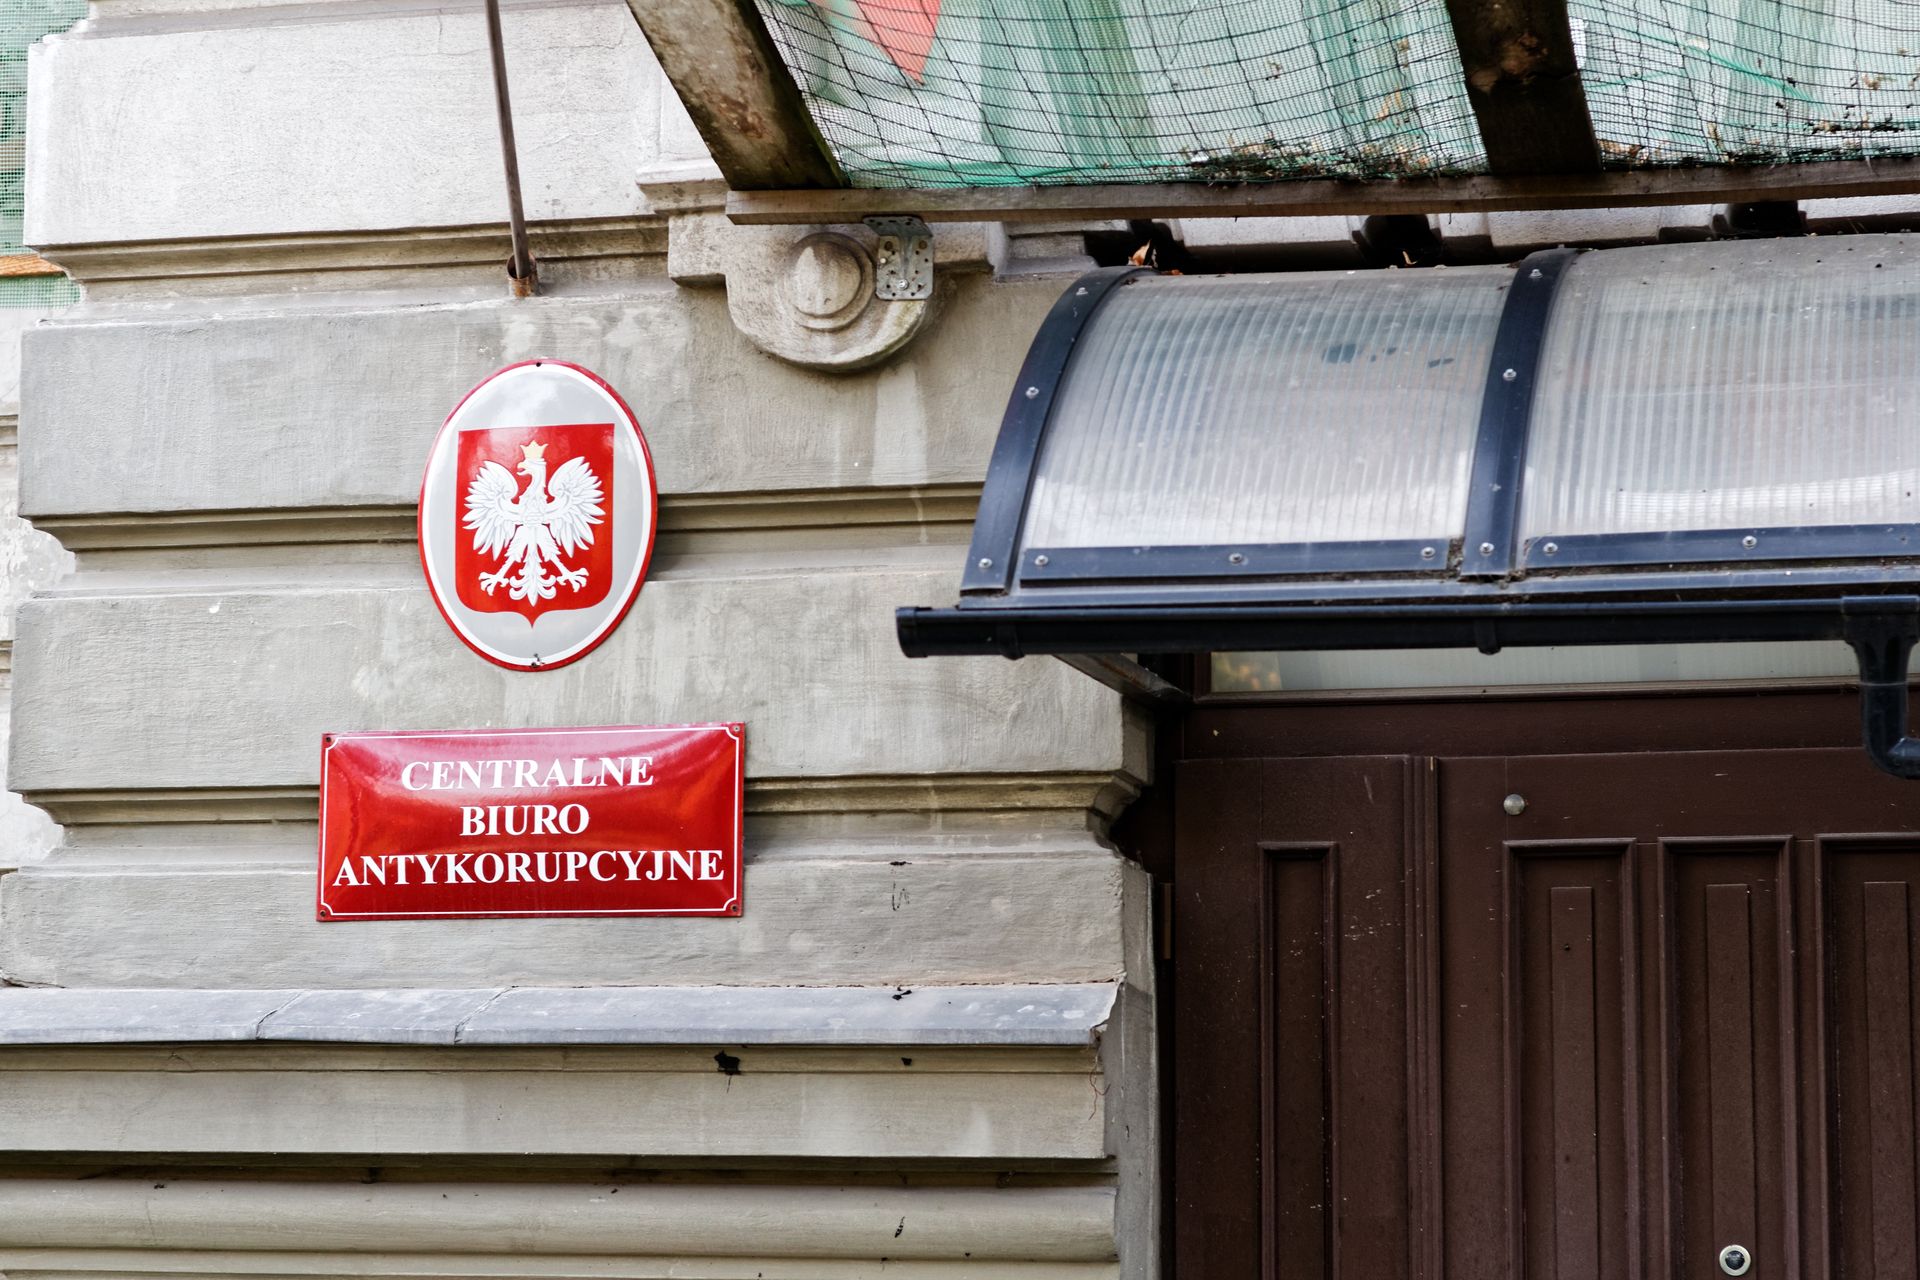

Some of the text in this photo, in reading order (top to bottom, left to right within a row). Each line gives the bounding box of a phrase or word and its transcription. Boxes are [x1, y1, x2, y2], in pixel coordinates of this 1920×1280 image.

[401, 756, 655, 791] CENTRALNE
[459, 804, 590, 836] BIURO
[332, 850, 725, 887] ANTYKORUPCYJNE
